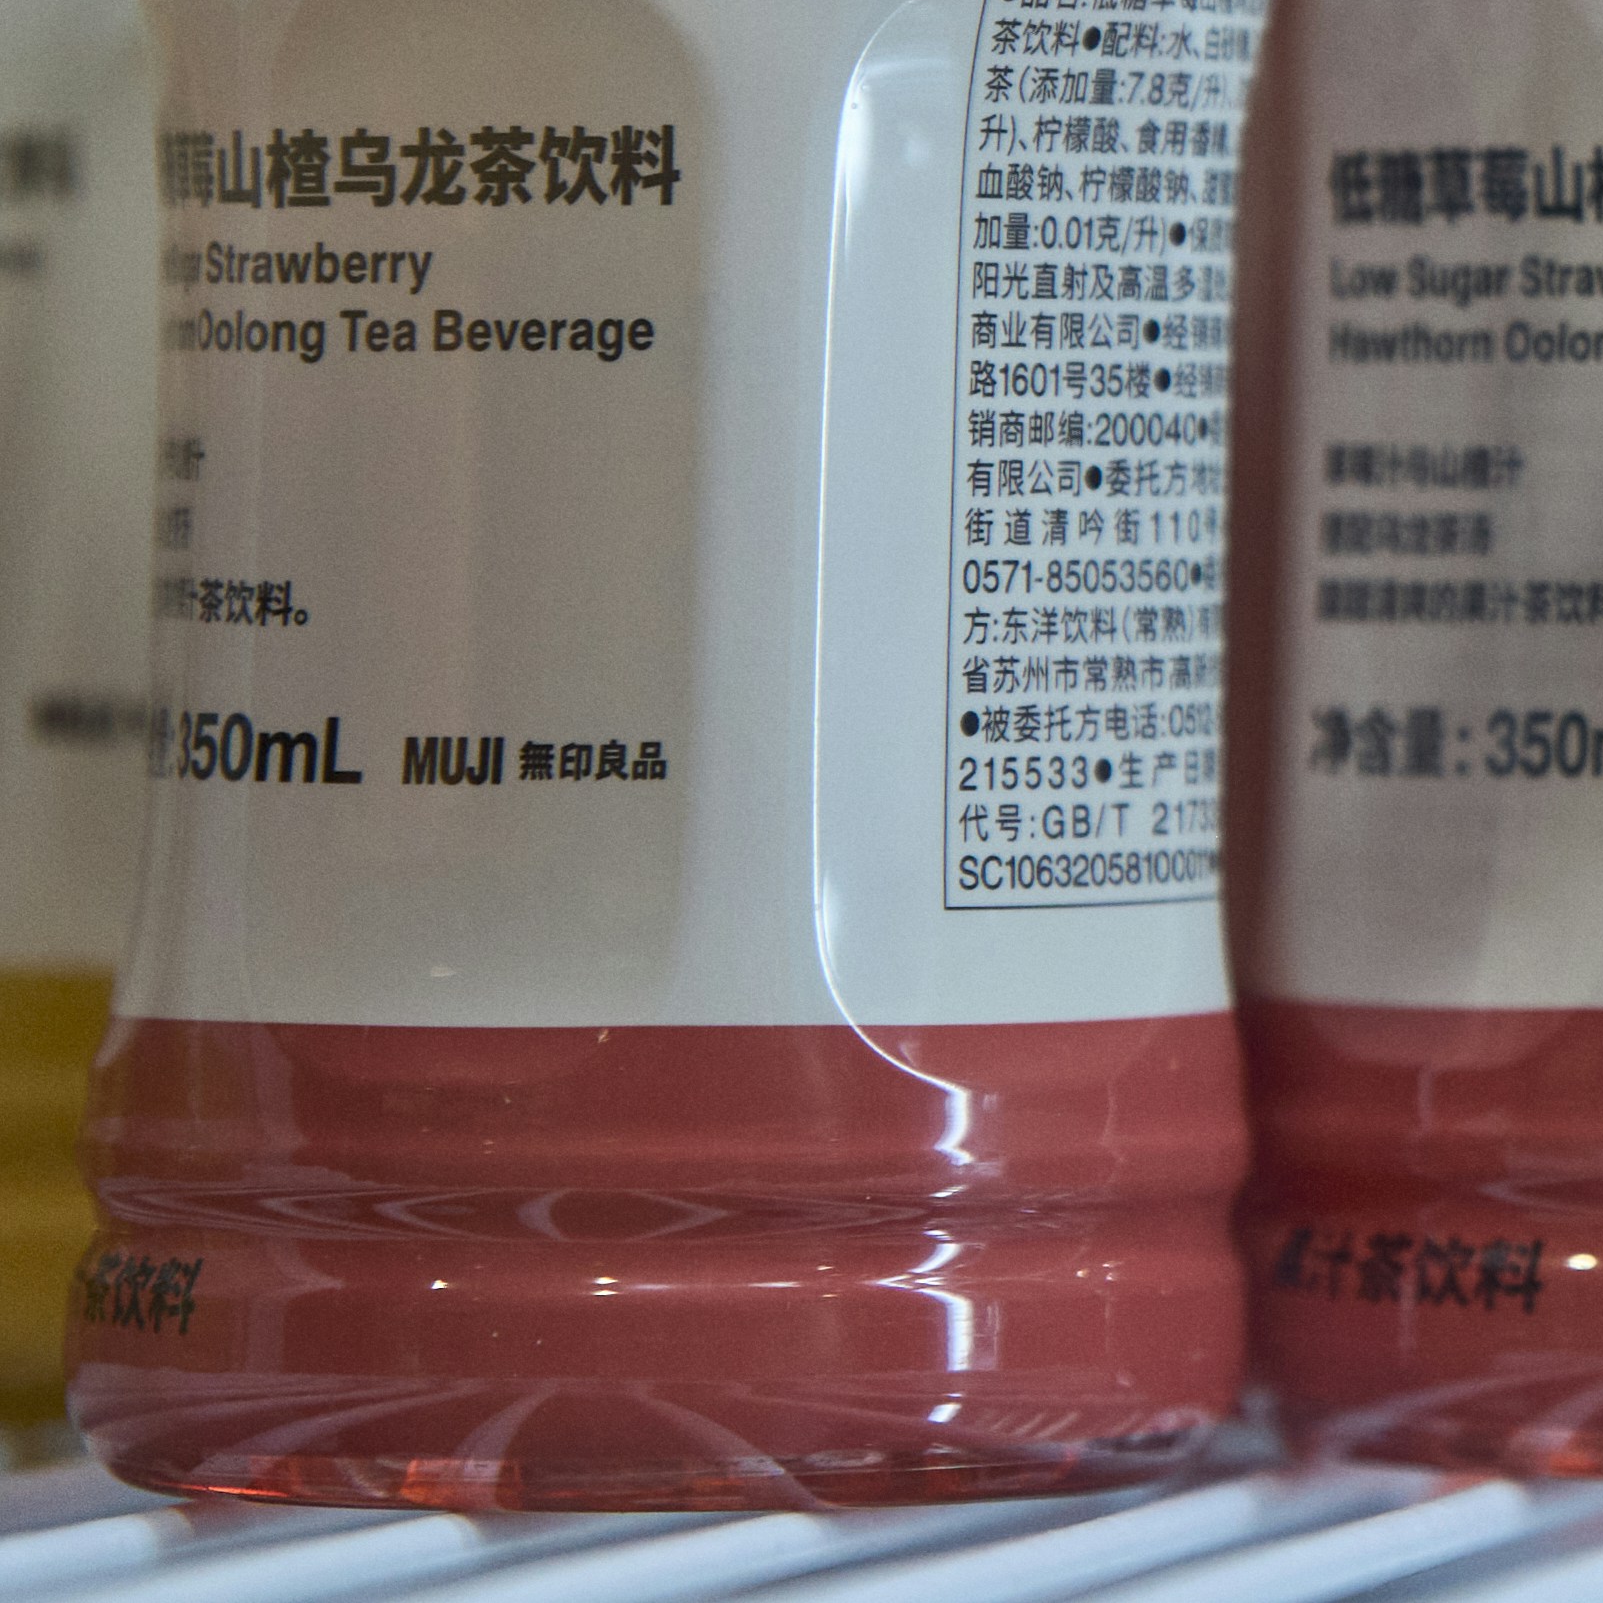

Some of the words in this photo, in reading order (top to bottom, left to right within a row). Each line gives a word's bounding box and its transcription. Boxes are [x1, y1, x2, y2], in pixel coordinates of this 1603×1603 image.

[205, 241, 432, 293] Strawberry
[1331, 256, 1396, 299] Low
[1406, 256, 1510, 307] Sugar
[340, 309, 417, 352] Tea
[433, 310, 655, 361] Beverage
[1329, 320, 1494, 364] Hawthorn
[402, 736, 504, 785] MUJI
[519, 740, 667, 782] 無印良品
